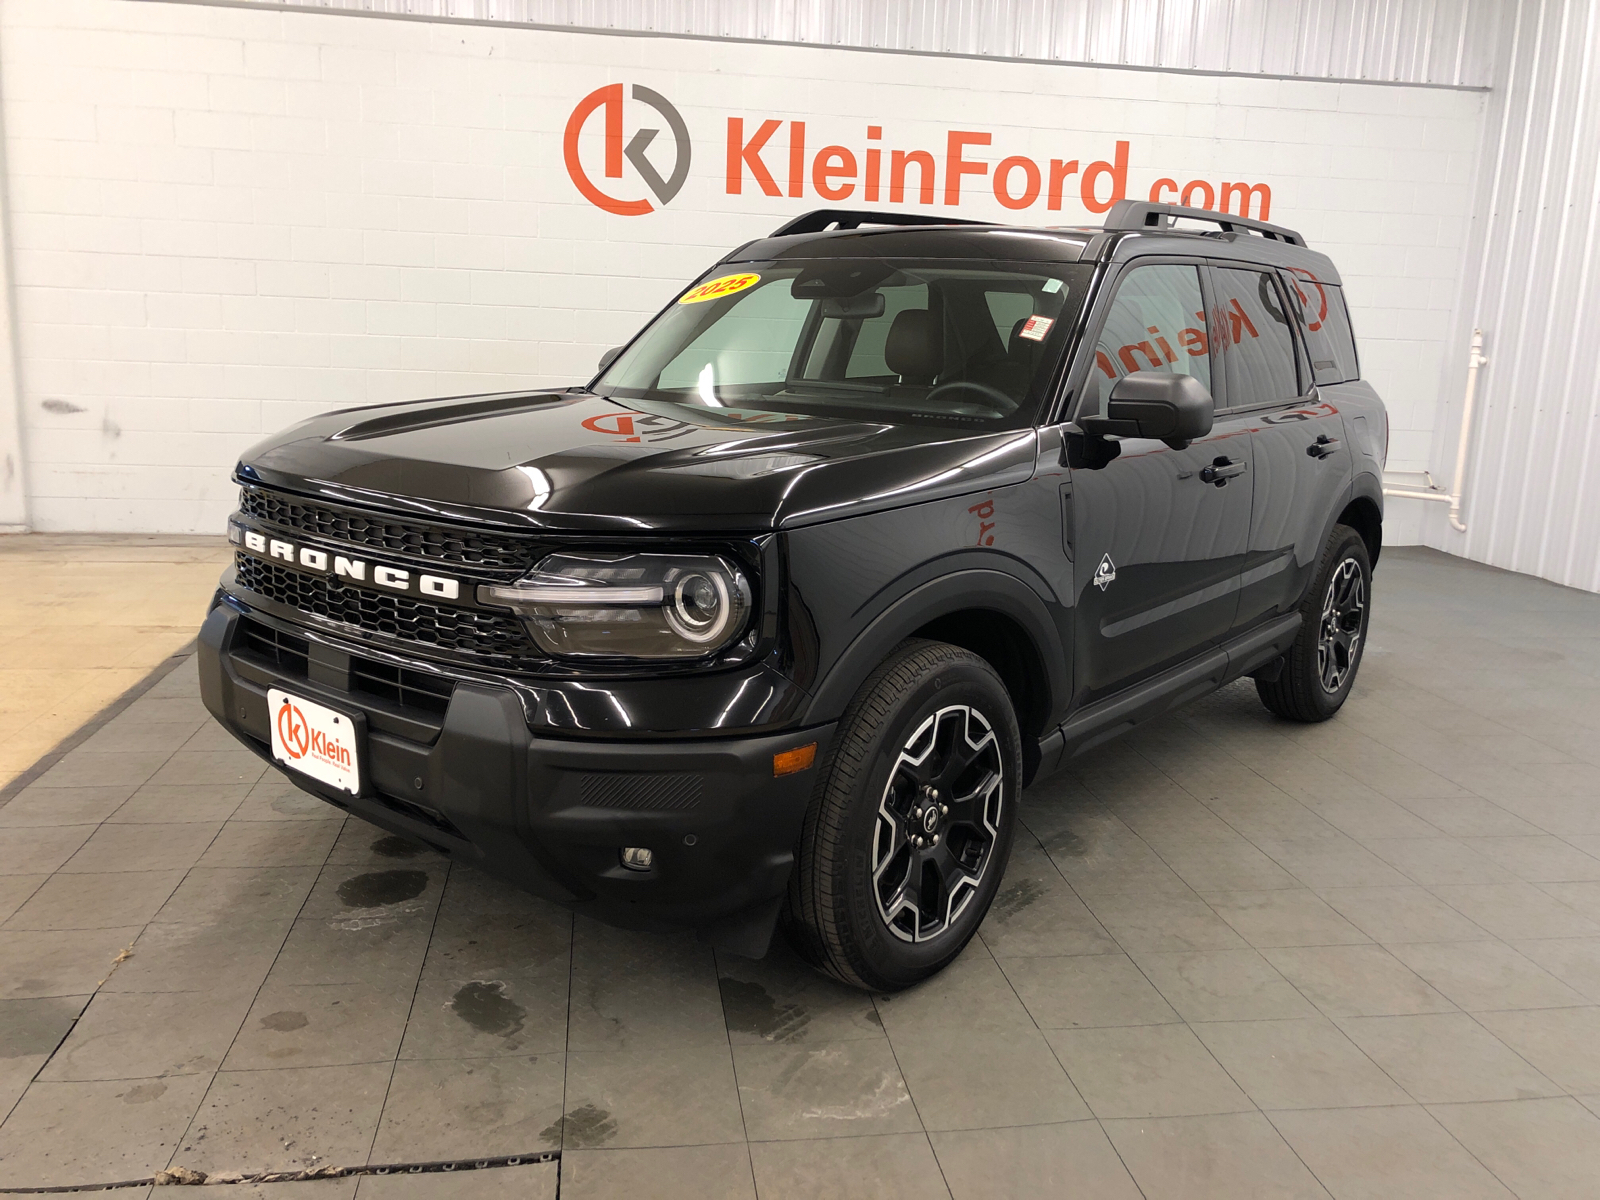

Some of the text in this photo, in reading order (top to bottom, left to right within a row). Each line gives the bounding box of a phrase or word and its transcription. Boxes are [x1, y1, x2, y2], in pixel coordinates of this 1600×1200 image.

[684, 276, 754, 301] 2025
[245, 530, 459, 600] BRONCO
[311, 728, 351, 766] Klein
